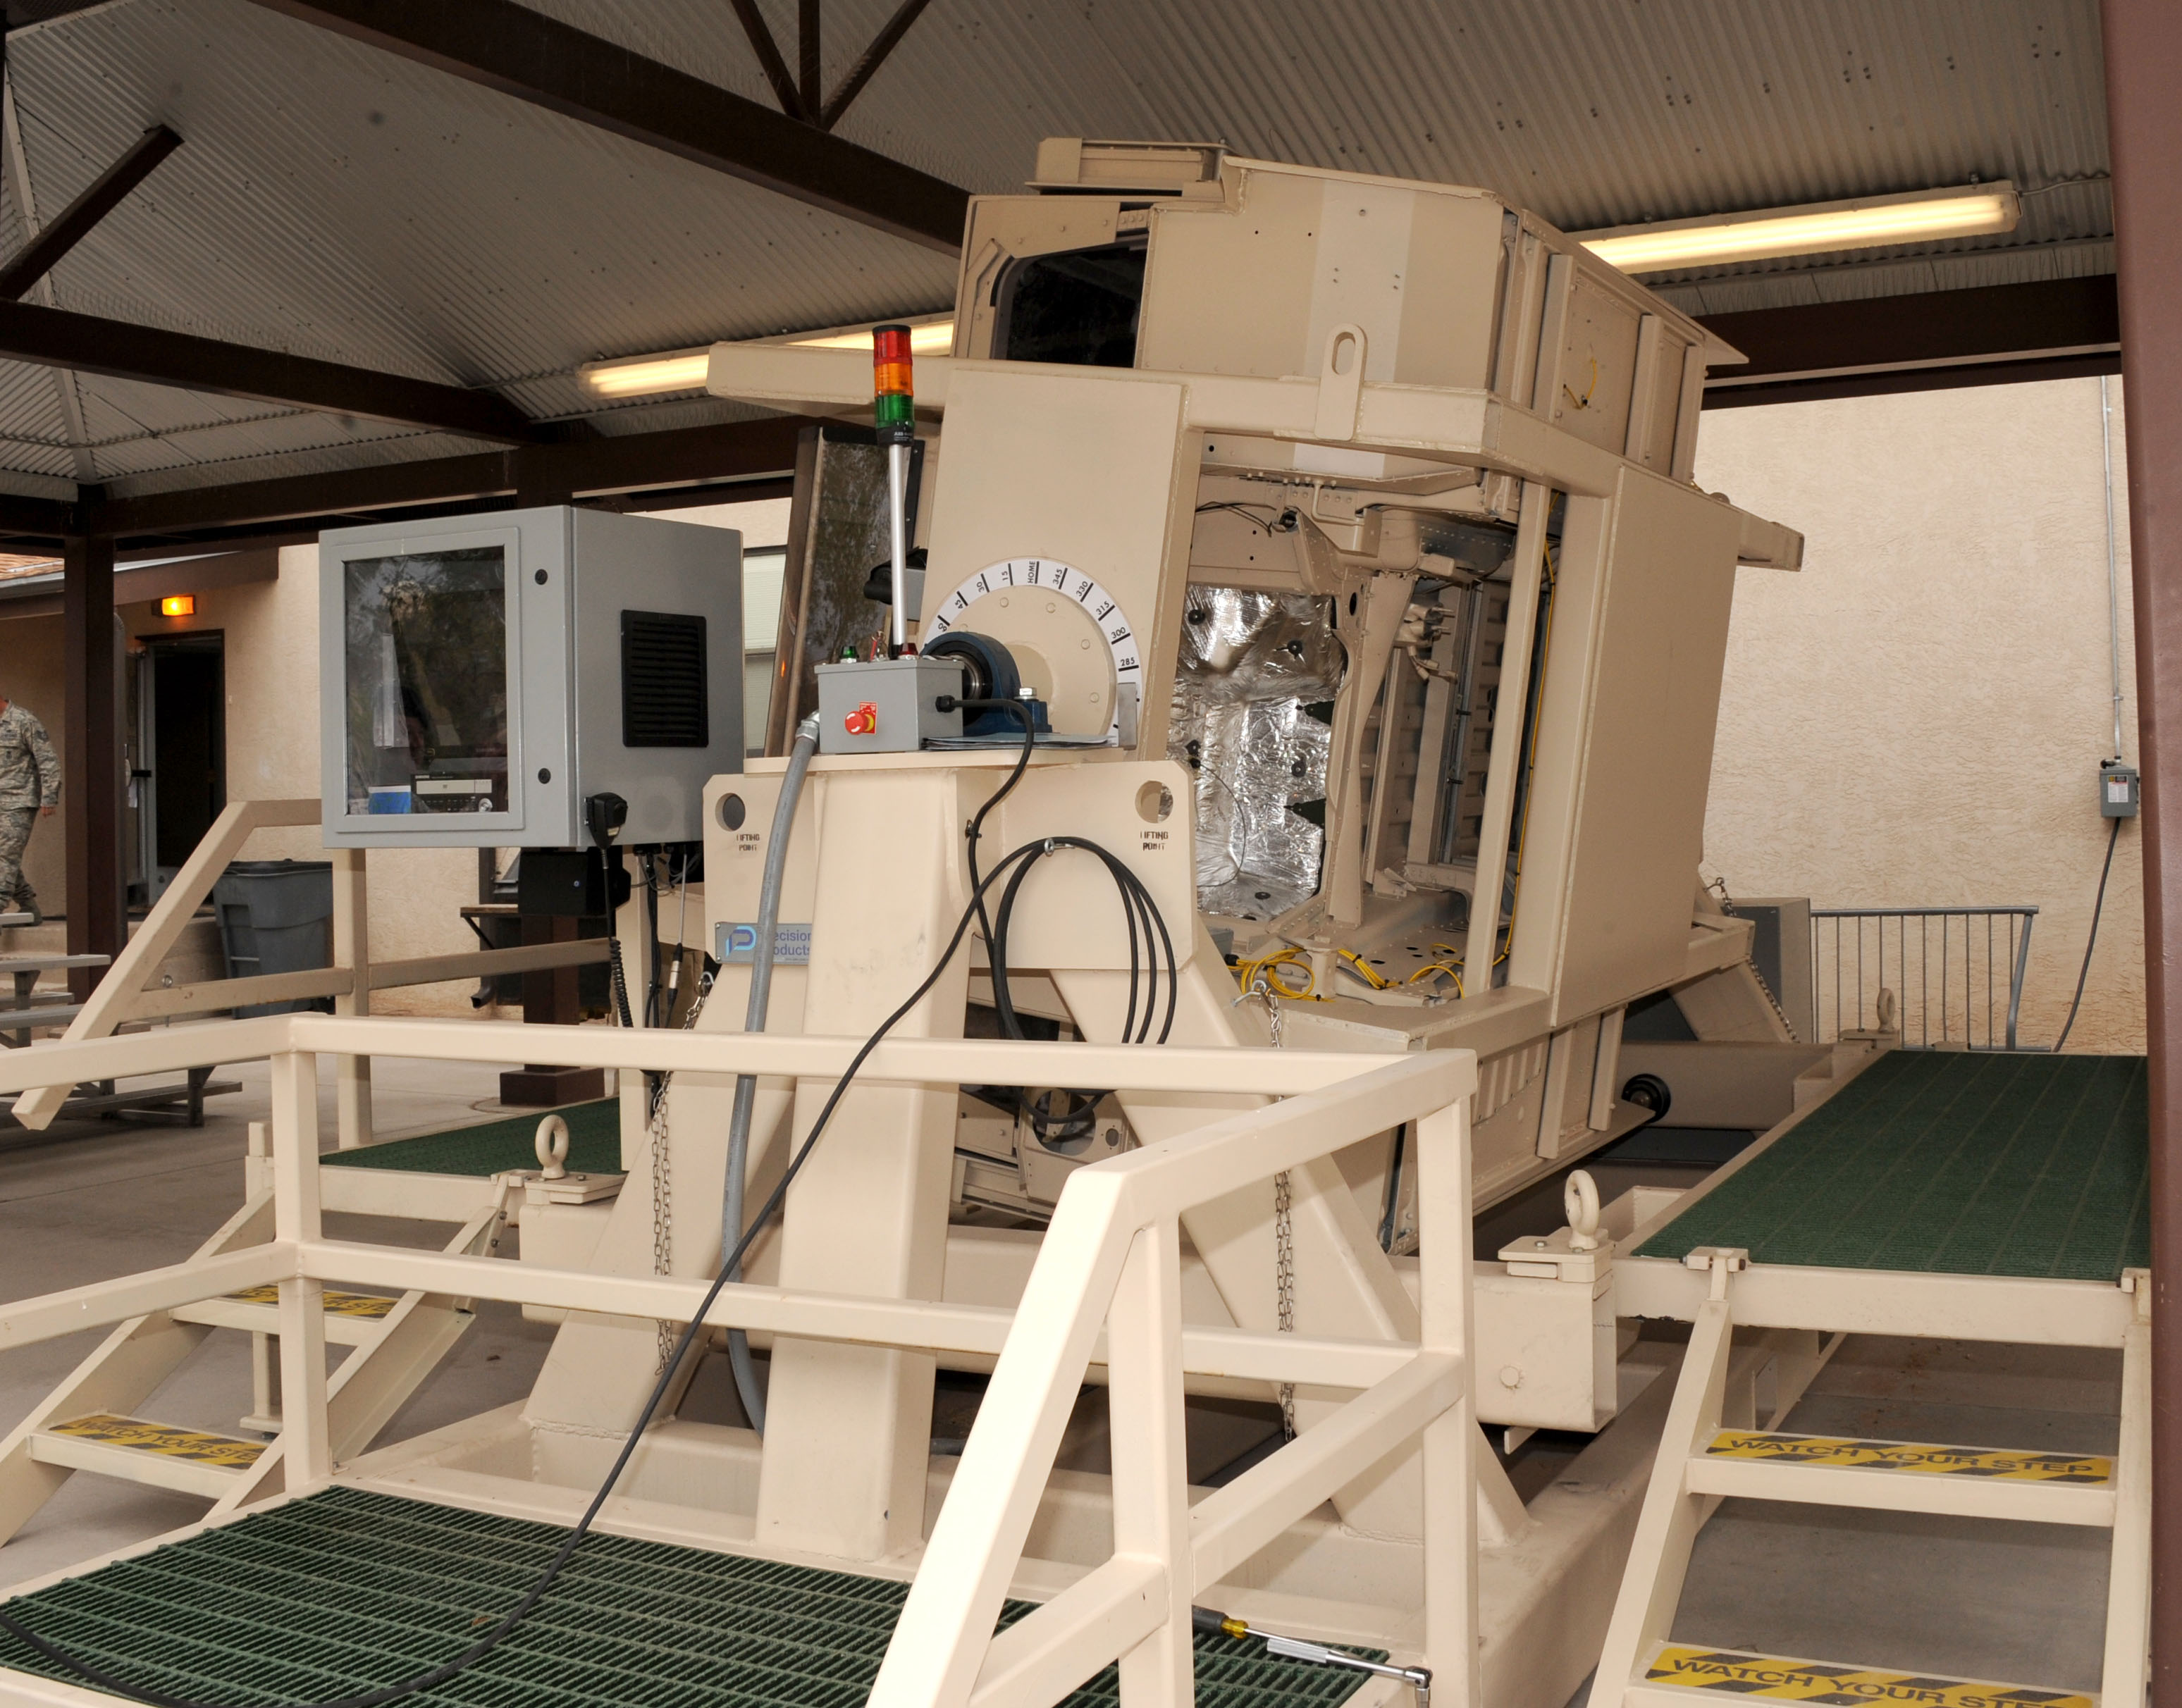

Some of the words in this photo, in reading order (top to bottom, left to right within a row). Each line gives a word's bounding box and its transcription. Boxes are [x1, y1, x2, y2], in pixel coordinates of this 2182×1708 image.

[1001, 571, 1009, 581] 15
[1052, 569, 1063, 585] 345
[976, 581, 985, 593] 30
[1075, 581, 1088, 597] 330
[955, 600, 963, 609] 45
[1096, 600, 1110, 615] 315
[938, 623, 947, 632] 60
[1111, 626, 1126, 639] 300
[1120, 657, 1135, 667] 285
[1140, 831, 1169, 840] LIFTING
[1142, 842, 1166, 851] POINT
[78, 1421, 154, 1439] WATCH
[152, 1435, 213, 1452] YOUR
[1730, 1440, 1860, 1457] WATCH
[1873, 1450, 1979, 1466] YOUR
[1992, 1459, 2093, 1474] STEP
[1674, 1659, 1815, 1688] WATCH
[1829, 1678, 1946, 1704] YOUR
